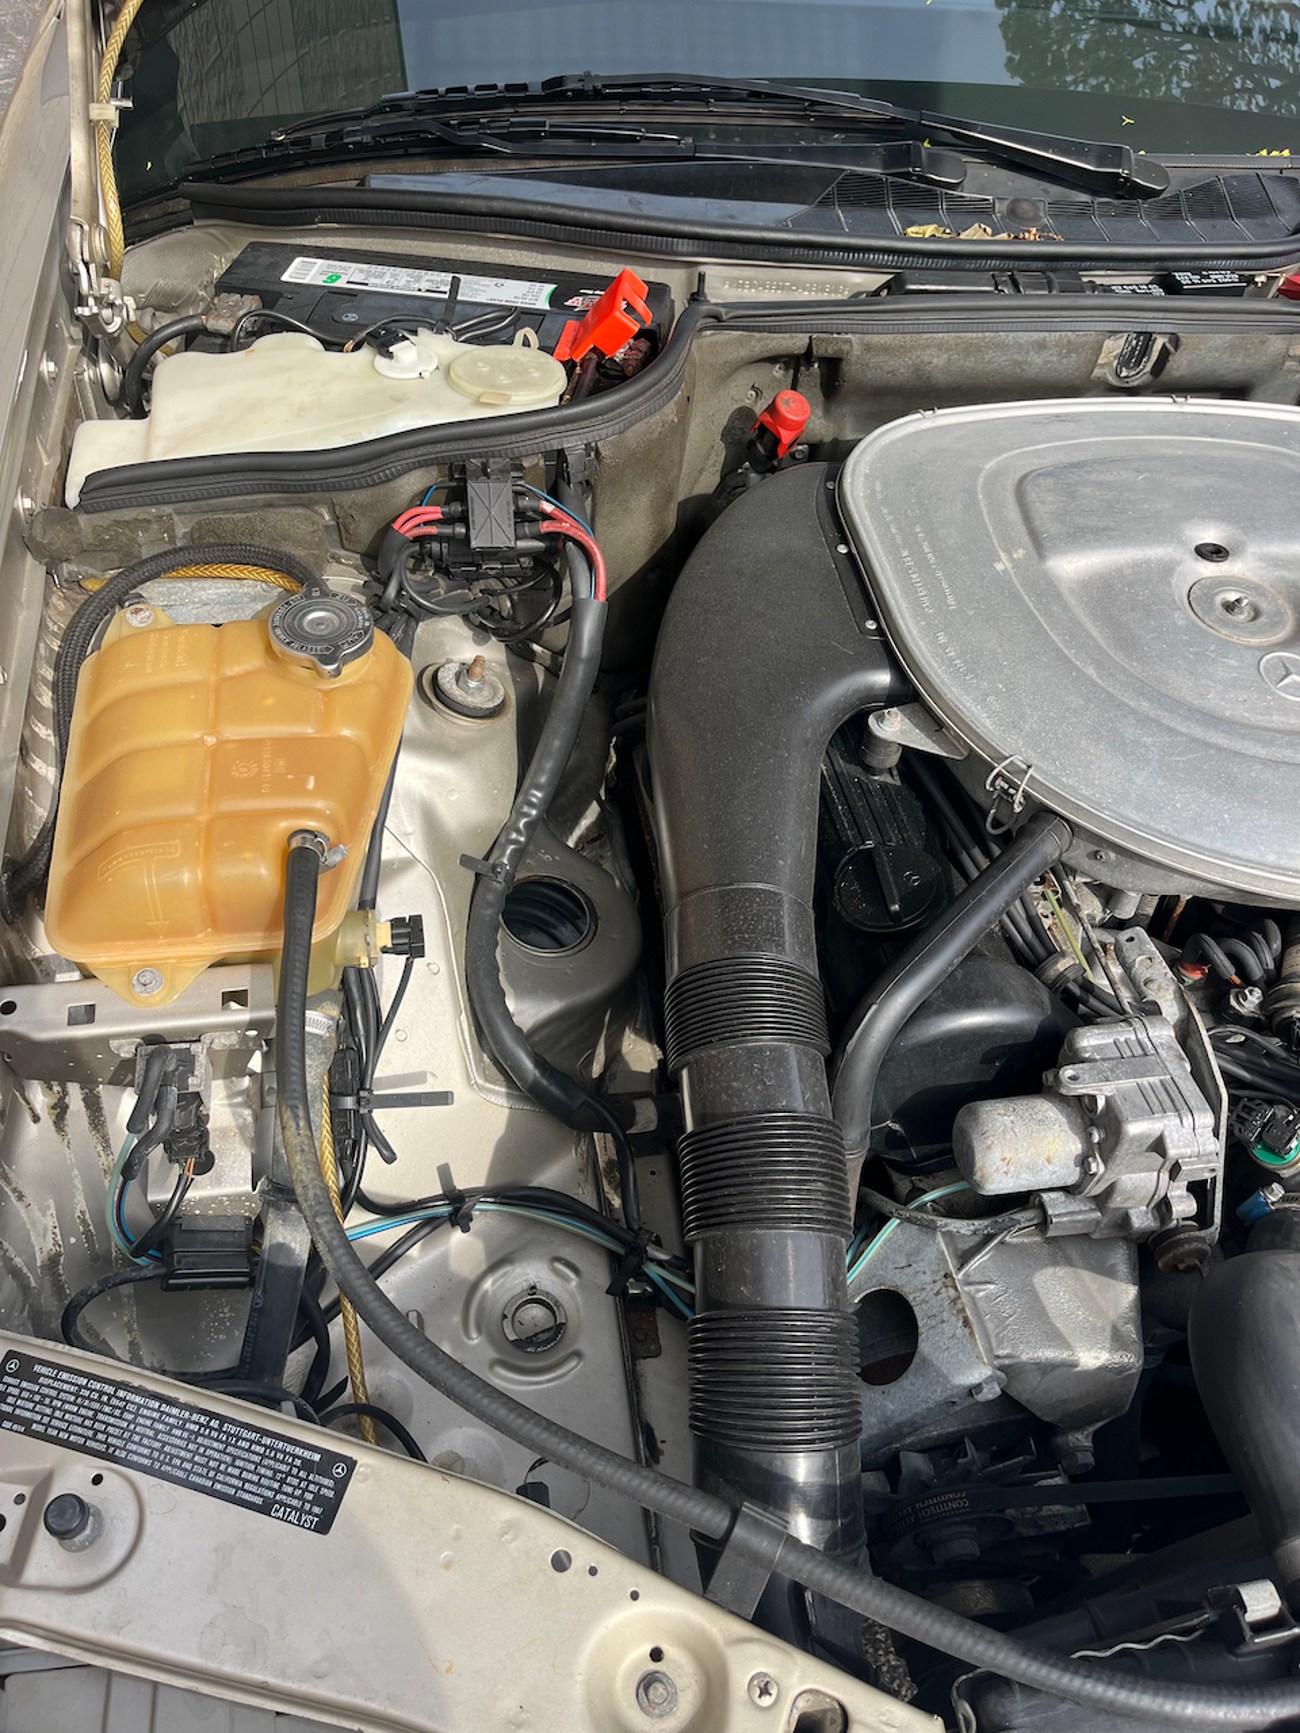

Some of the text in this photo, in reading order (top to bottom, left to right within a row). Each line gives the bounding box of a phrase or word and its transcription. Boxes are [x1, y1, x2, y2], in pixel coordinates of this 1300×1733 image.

[33, 1364, 58, 1377] VEHICLE
[57, 1371, 87, 1387] EMISSION
[87, 1380, 116, 1395] CONTROL
[116, 1388, 160, 1409] INFORMATION
[160, 1403, 209, 1425] DAIMLER-BENZ
[139, 1407, 161, 1419] ENGINE
[237, 1439, 250, 1449] AND
[93, 1422, 106, 1431] BEEN
[106, 1425, 123, 1436] PRESET
[163, 1444, 193, 1460] ADJUSTMENT
[193, 1454, 208, 1465] MUST
[226, 1466, 241, 1476] MADE
[241, 1471, 260, 1483] DURING
[259, 1477, 280, 1490] ROUTINE
[107, 1436, 126, 1447] VEHICLE
[126, 1442, 152, 1456] CONFORMS
[192, 1464, 209, 1475] STATE
[216, 1472, 243, 1487] CALIFORNIA
[244, 1482, 275, 1498] REGULATIONS
[275, 1493, 302, 1508] APPLICABLE
[127, 1453, 152, 1466] CONFORMS
[161, 1464, 189, 1479] APPLICABLE
[188, 1473, 213, 1487] CANADIAN
[213, 1482, 236, 1495] EMISSION
[234, 1458, 256, 1471] IGNITION
[270, 1503, 320, 1531] CATALYST
[918, 1499, 969, 1520] CONTITECH
